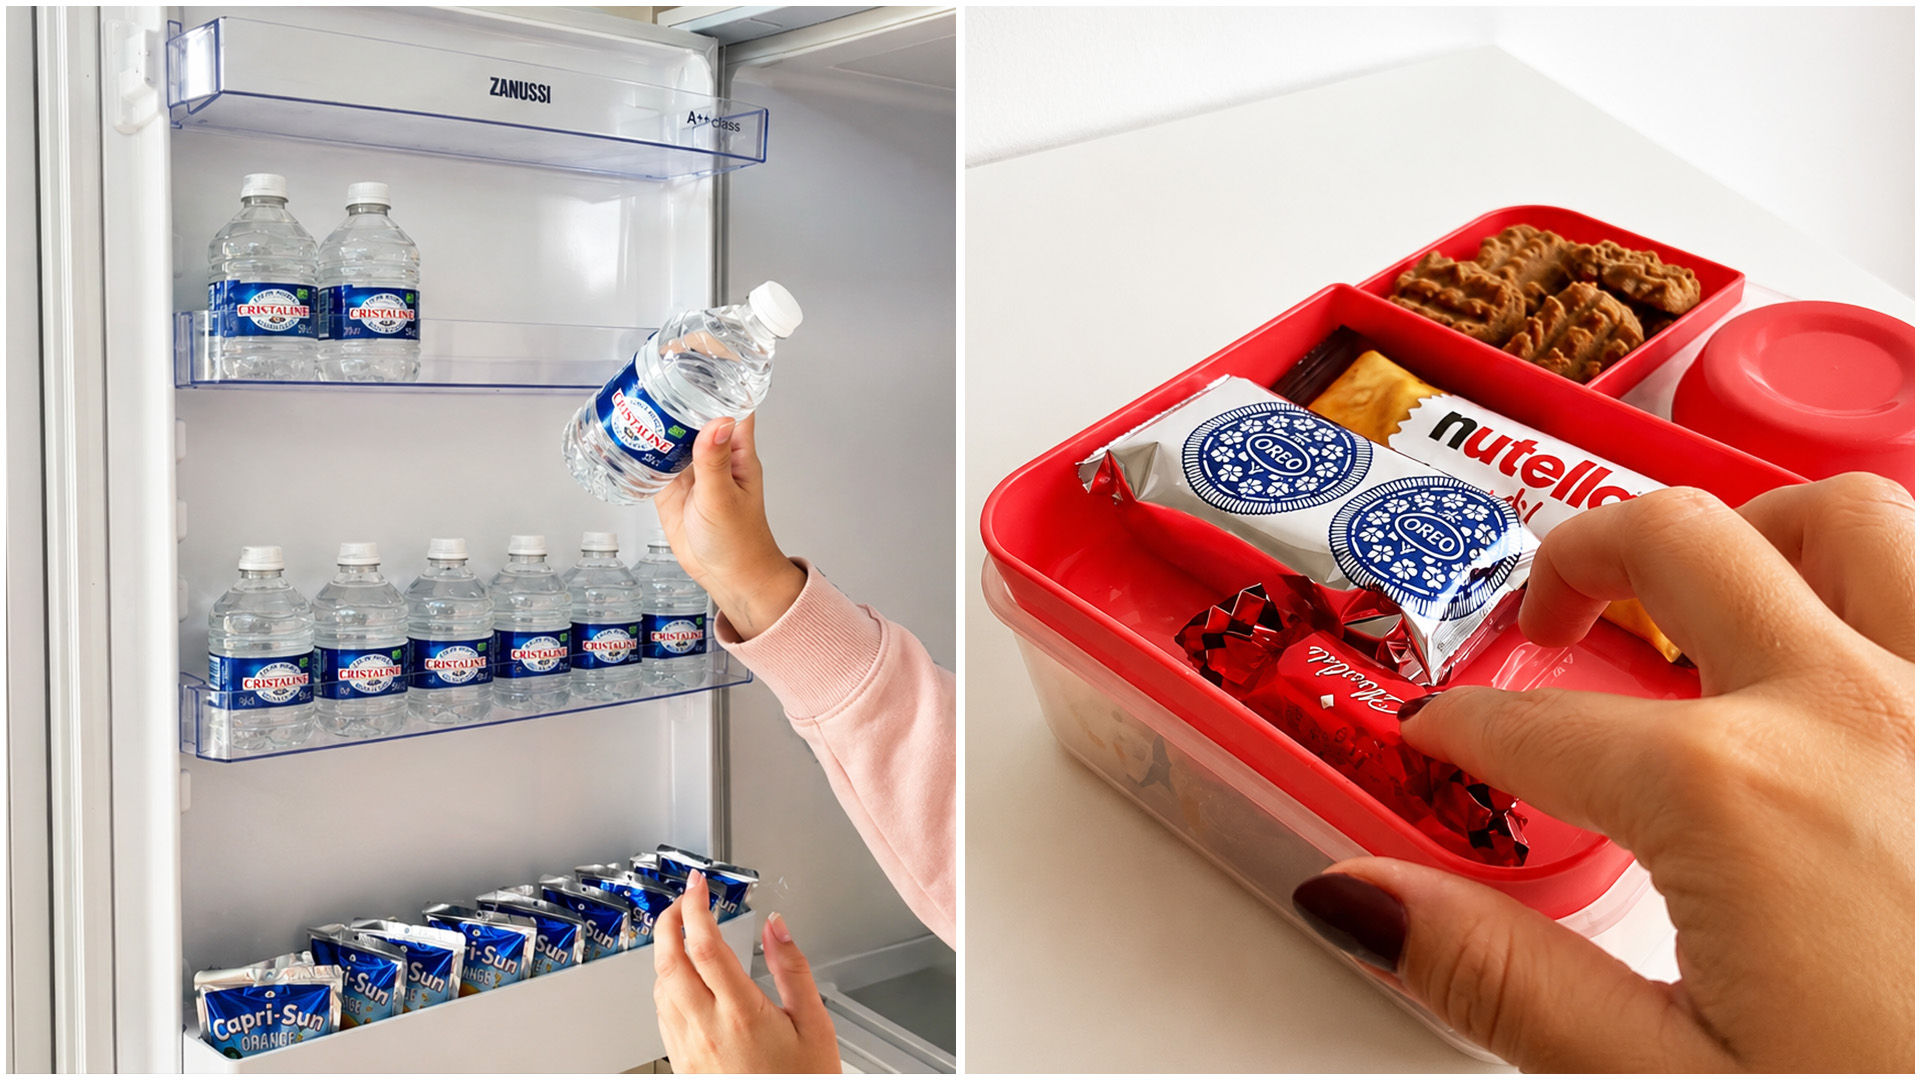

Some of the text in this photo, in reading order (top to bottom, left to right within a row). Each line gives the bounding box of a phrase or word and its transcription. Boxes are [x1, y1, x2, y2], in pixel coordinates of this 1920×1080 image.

[490, 77, 551, 104] ZANUSSI
[711, 117, 741, 132] class
[238, 304, 309, 317] CRISTALINE
[350, 308, 415, 320] CRISTALINE
[613, 392, 673, 453] CRISTALINE
[1254, 437, 1304, 471] OREO
[1403, 517, 1456, 552] OREO
[651, 630, 703, 641] CRISTALINE
[583, 639, 637, 650] CRISTALINE
[512, 647, 568, 659] CRISTALINE
[425, 656, 487, 669] CRISTALINE
[339, 665, 401, 680] CRISTALINE
[243, 673, 309, 690] CRISTALINE
[213, 1003, 324, 1040] Capri-Sun
[241, 1032, 295, 1051] ORANGE
